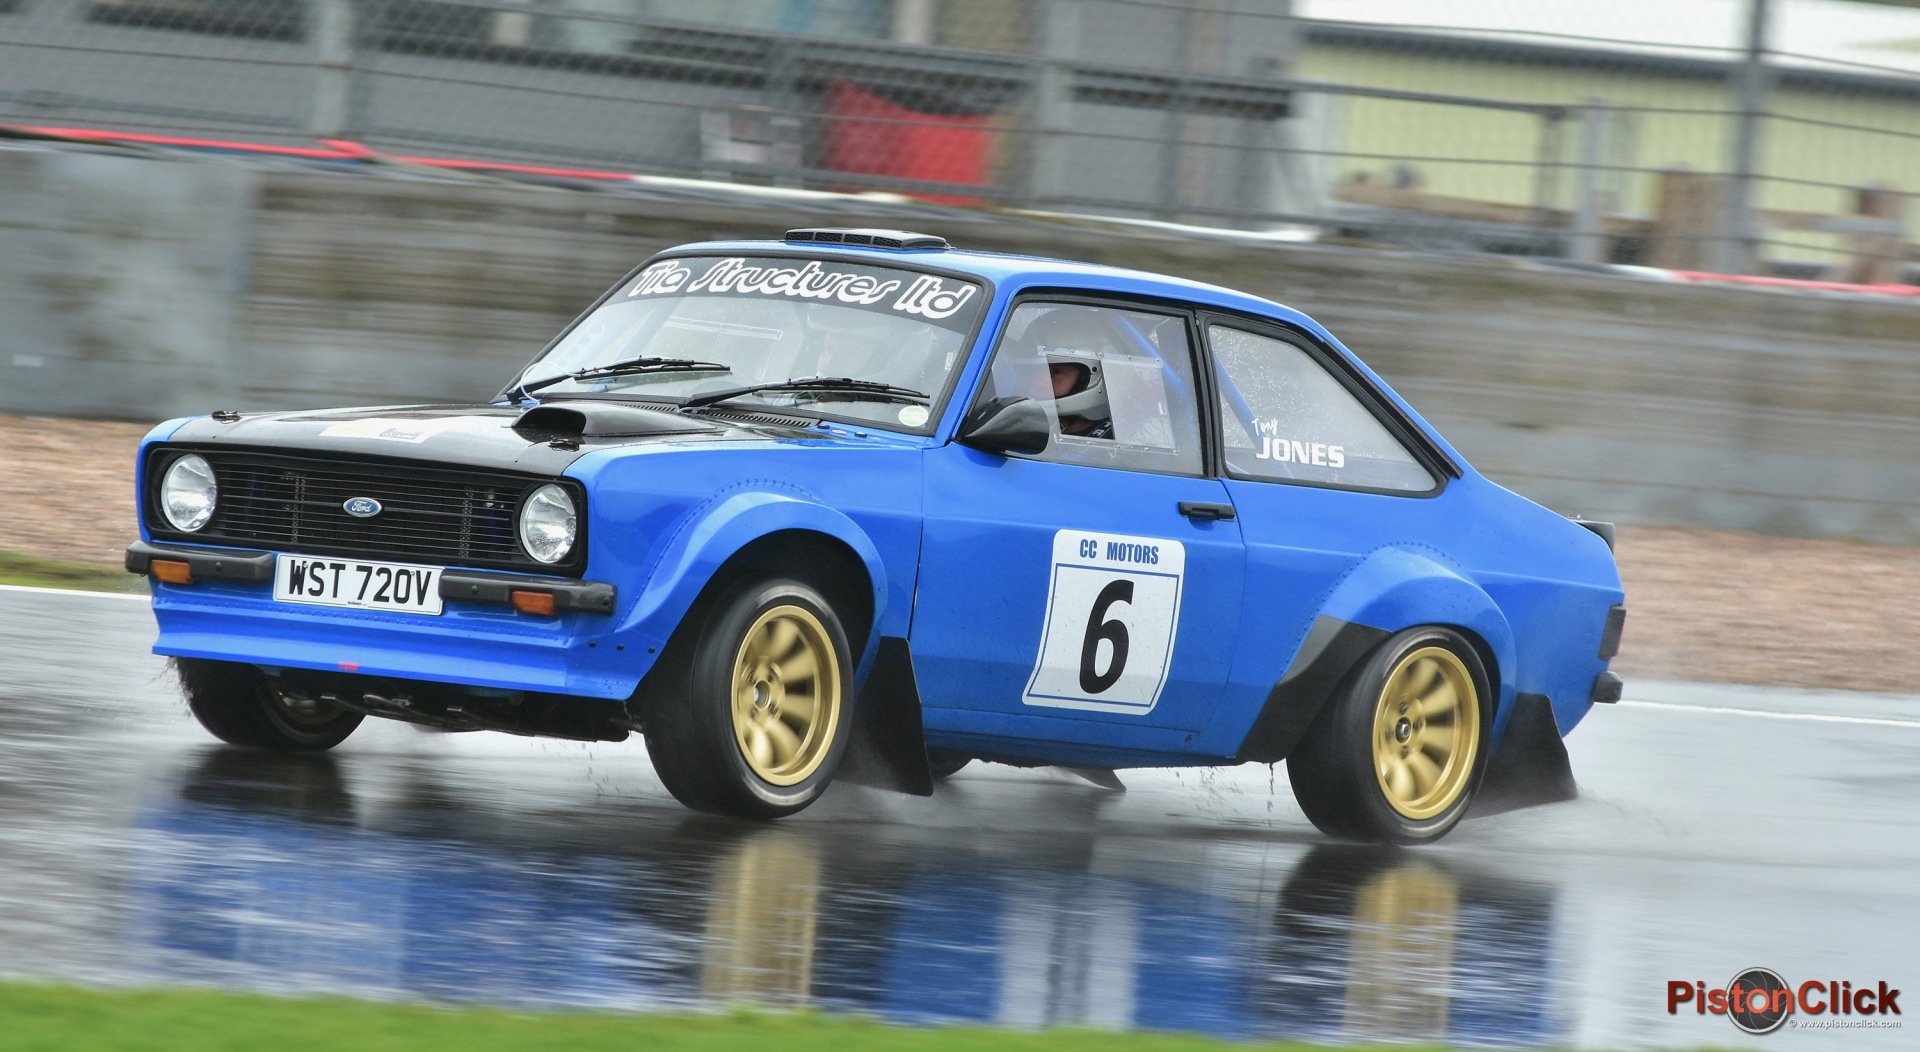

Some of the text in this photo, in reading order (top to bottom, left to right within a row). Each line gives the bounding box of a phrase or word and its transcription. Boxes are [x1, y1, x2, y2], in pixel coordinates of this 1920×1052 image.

[628, 260, 691, 297] Tia
[687, 257, 902, 304] Structures
[1251, 417, 1278, 436] Tony
[1255, 436, 1345, 469] JONES
[351, 500, 373, 513] Ford
[1079, 538, 1159, 565] CC MOTORS
[288, 558, 433, 606] WST 720V
[1078, 578, 1135, 694] 6
